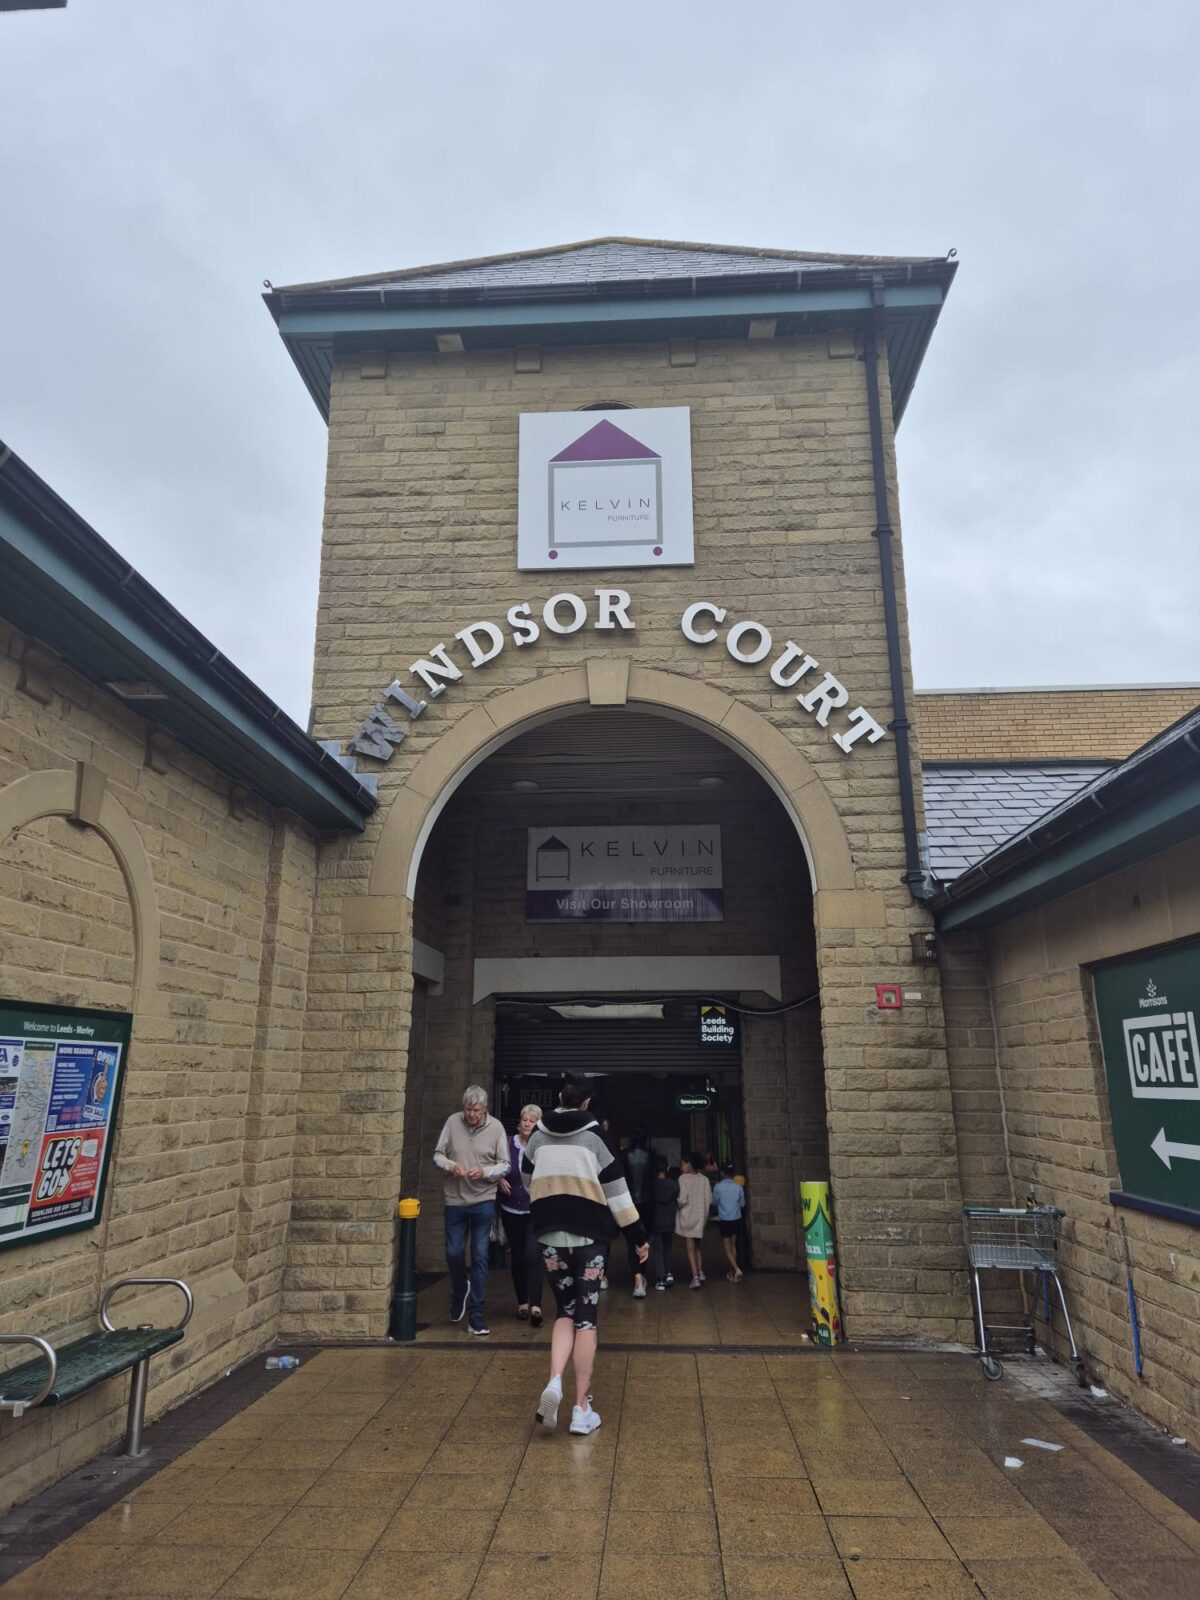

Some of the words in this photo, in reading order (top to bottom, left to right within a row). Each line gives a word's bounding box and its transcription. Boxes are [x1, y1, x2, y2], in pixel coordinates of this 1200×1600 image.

[560, 498, 651, 511] KELVIN
[607, 514, 650, 522] FURNITURE
[349, 589, 635, 761] WINDSOR
[681, 601, 886, 754] COURT
[580, 839, 714, 857] KELVIN
[650, 866, 713, 876] FURNITURE
[556, 898, 587, 910] Visit
[591, 898, 616, 910] Our
[620, 897, 694, 910] Showroom
[1139, 996, 1168, 1009] Morrisons
[701, 1016, 726, 1025] Leeds
[23, 1021, 49, 1032] Welcome
[50, 1024, 56, 1032] to
[57, 1023, 73, 1034] Leeds
[76, 1025, 95, 1037] Morley
[701, 1025, 734, 1035] Building
[701, 1034, 733, 1044] Society
[43, 1138, 82, 1170] LETS
[37, 1169, 62, 1199] GO
